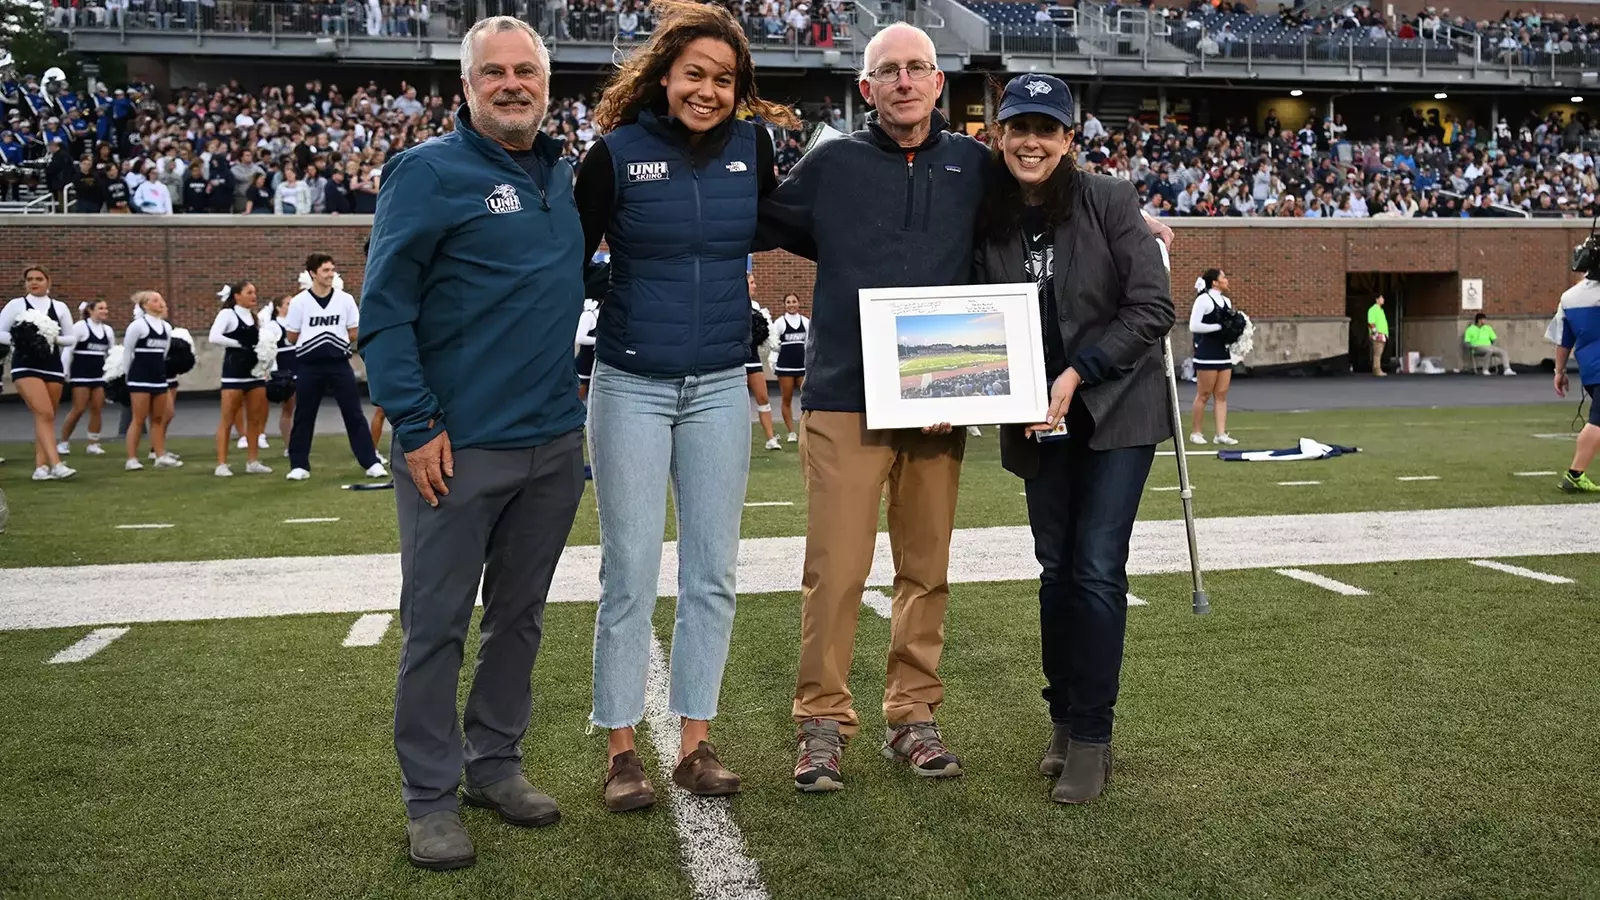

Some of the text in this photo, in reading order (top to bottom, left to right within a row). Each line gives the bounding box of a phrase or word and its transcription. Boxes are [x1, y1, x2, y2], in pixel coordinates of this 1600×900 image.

[630, 162, 666, 175] UNH
[490, 195, 518, 209] UNH
[309, 314, 340, 327] UNH
